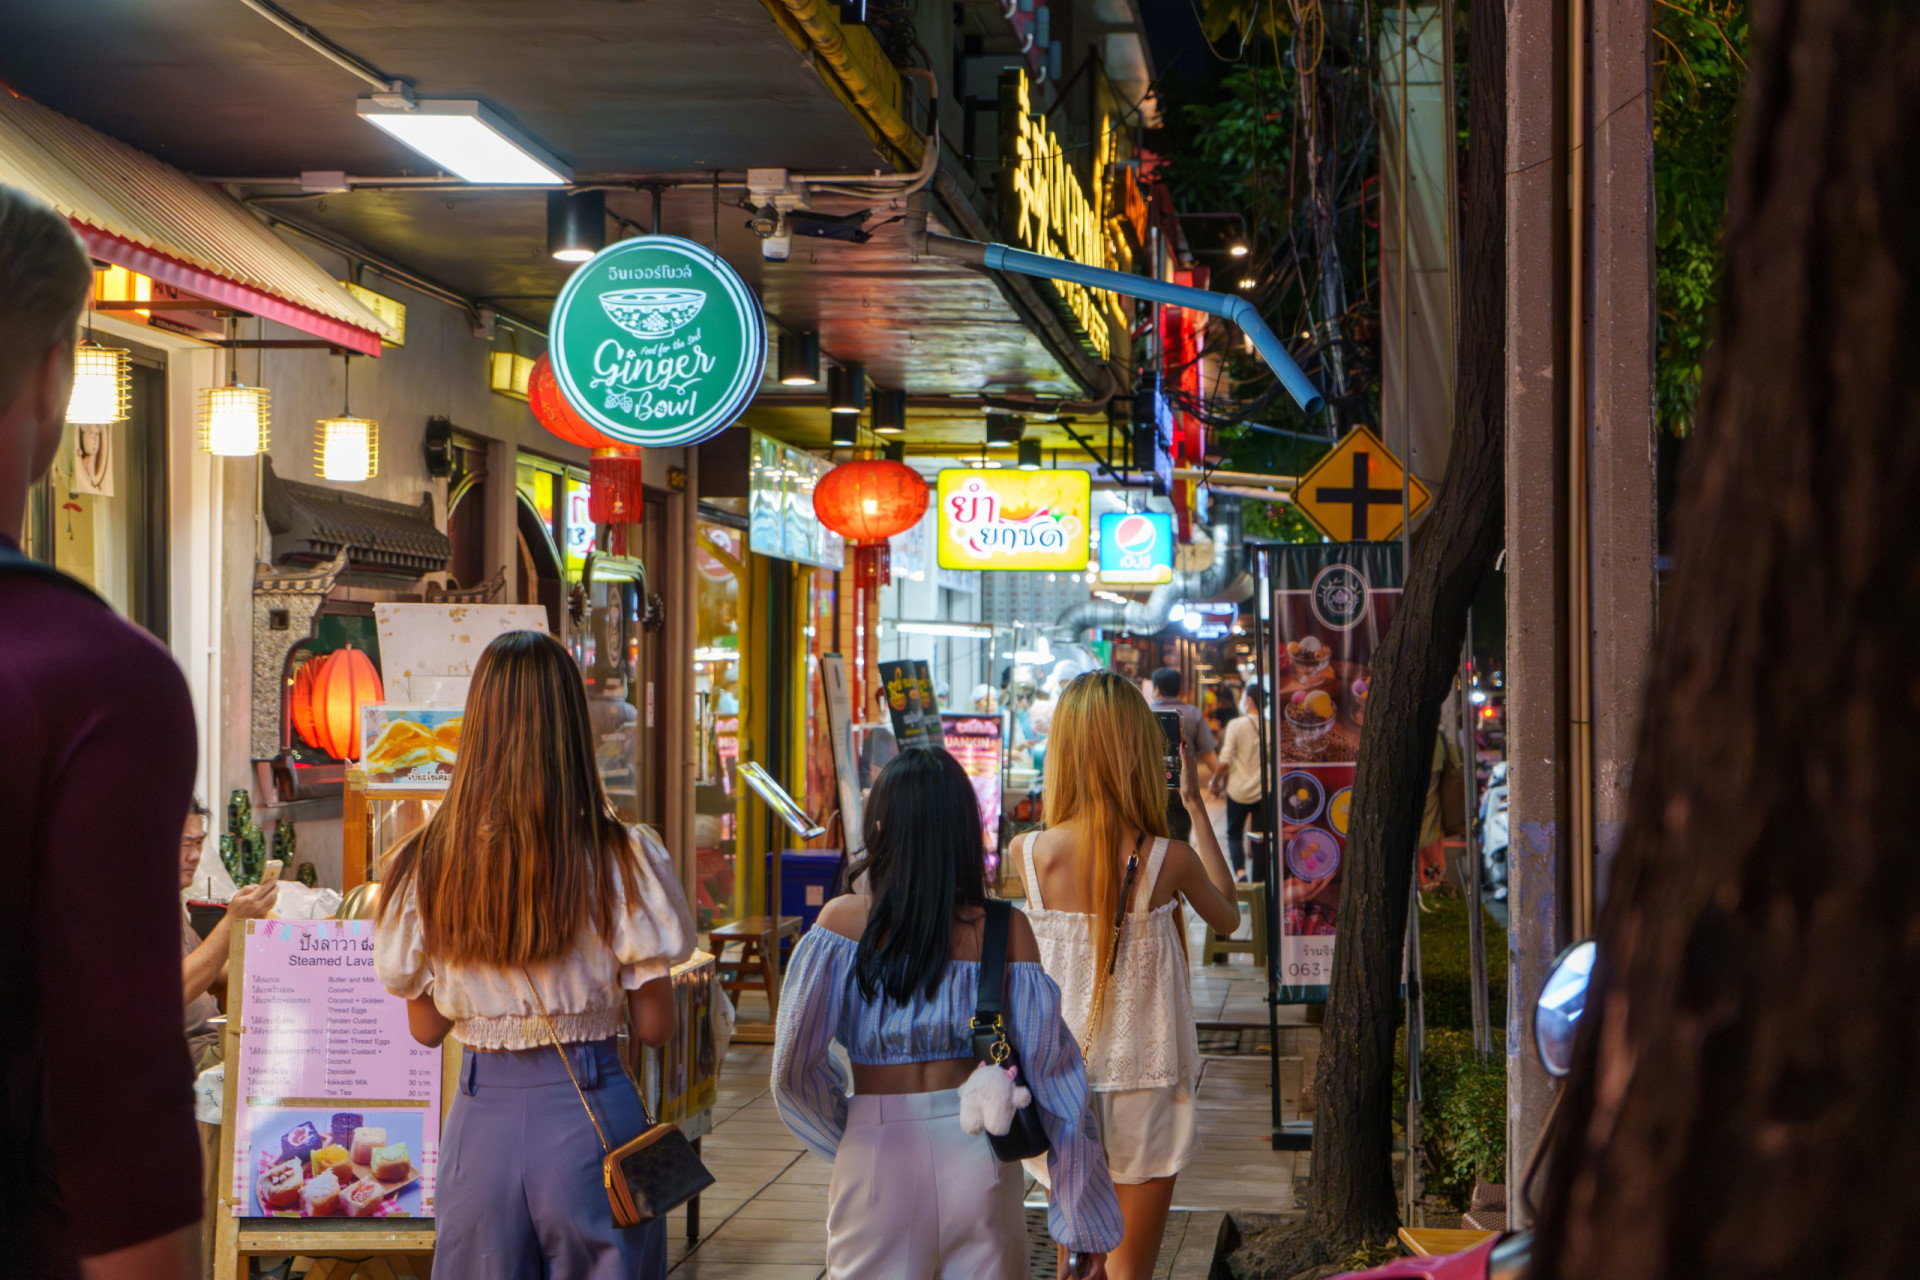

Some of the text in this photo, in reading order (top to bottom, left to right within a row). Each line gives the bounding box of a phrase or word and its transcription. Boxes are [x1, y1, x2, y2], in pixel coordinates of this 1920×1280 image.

[657, 342, 671, 358] for
[672, 338, 686, 351] the
[686, 327, 702, 346] Soul
[590, 338, 717, 391] Ginger
[634, 391, 698, 421] Bowl
[951, 483, 994, 524] ยำ
[299, 933, 357, 951] ปังลาวา
[288, 955, 375, 967] Steamed Lava
[328, 976, 376, 984] Butter and Milk
[328, 1006, 368, 1016] Thread Eggs
[350, 1037, 373, 1045] Thread
[374, 1037, 391, 1046] Eggs
[408, 1089, 417, 1097] 30
